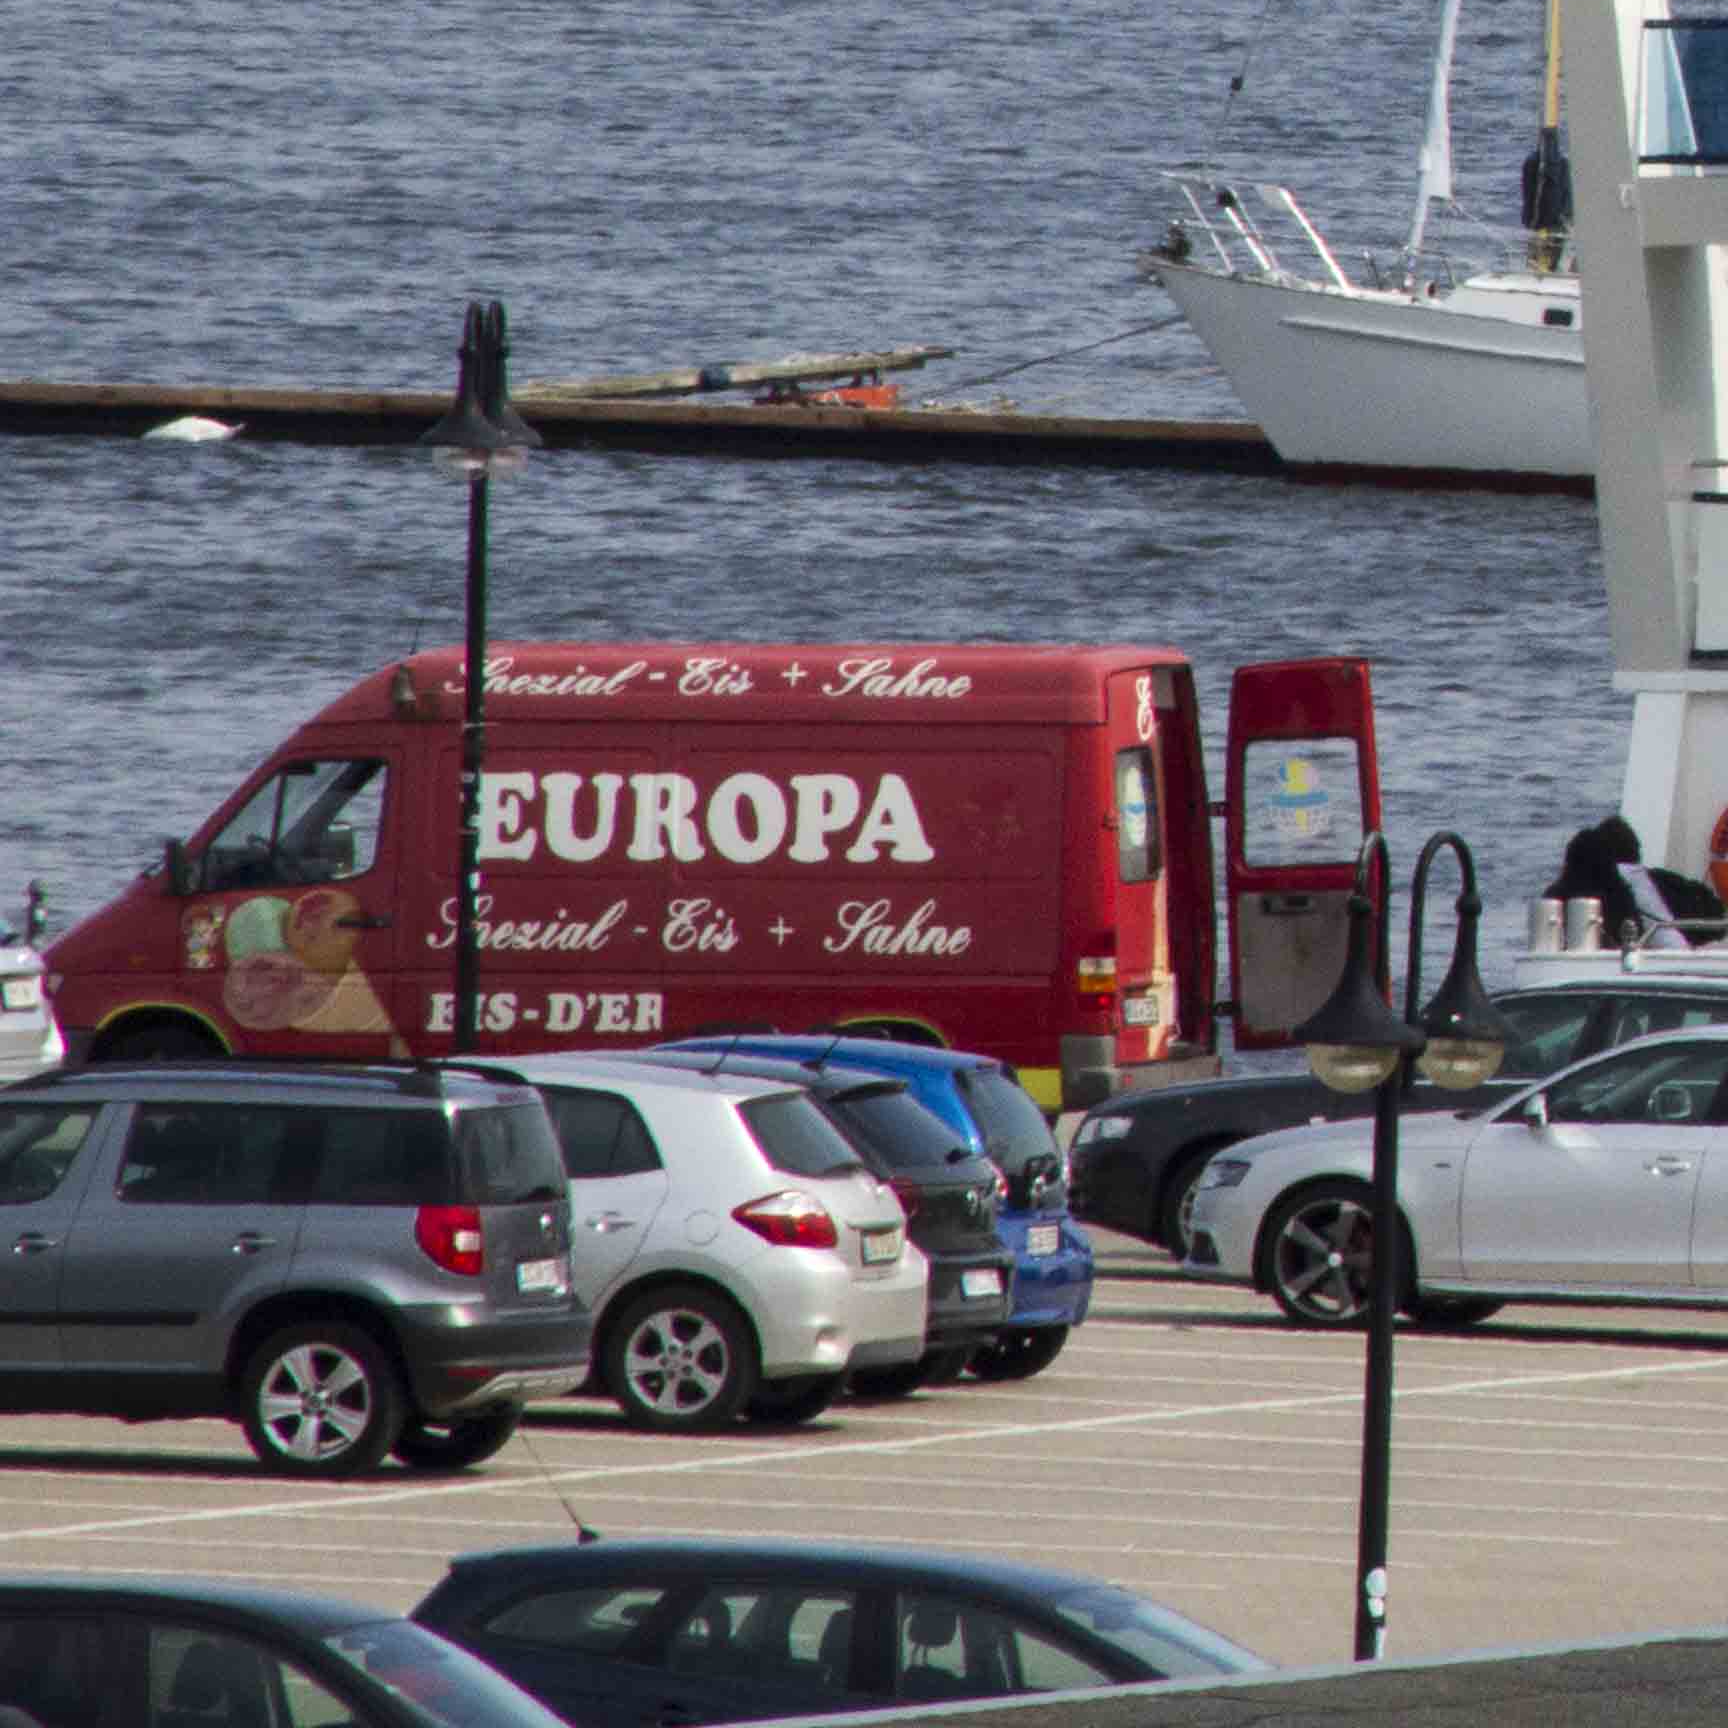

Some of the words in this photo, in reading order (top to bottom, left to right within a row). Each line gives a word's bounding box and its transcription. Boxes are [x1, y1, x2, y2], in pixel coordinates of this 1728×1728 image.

[678, 656, 756, 698] Eis
[822, 658, 973, 700] Sahne
[472, 771, 935, 864] EUROPA
[662, 898, 740, 954] Eis
[822, 898, 972, 957] Sahne
